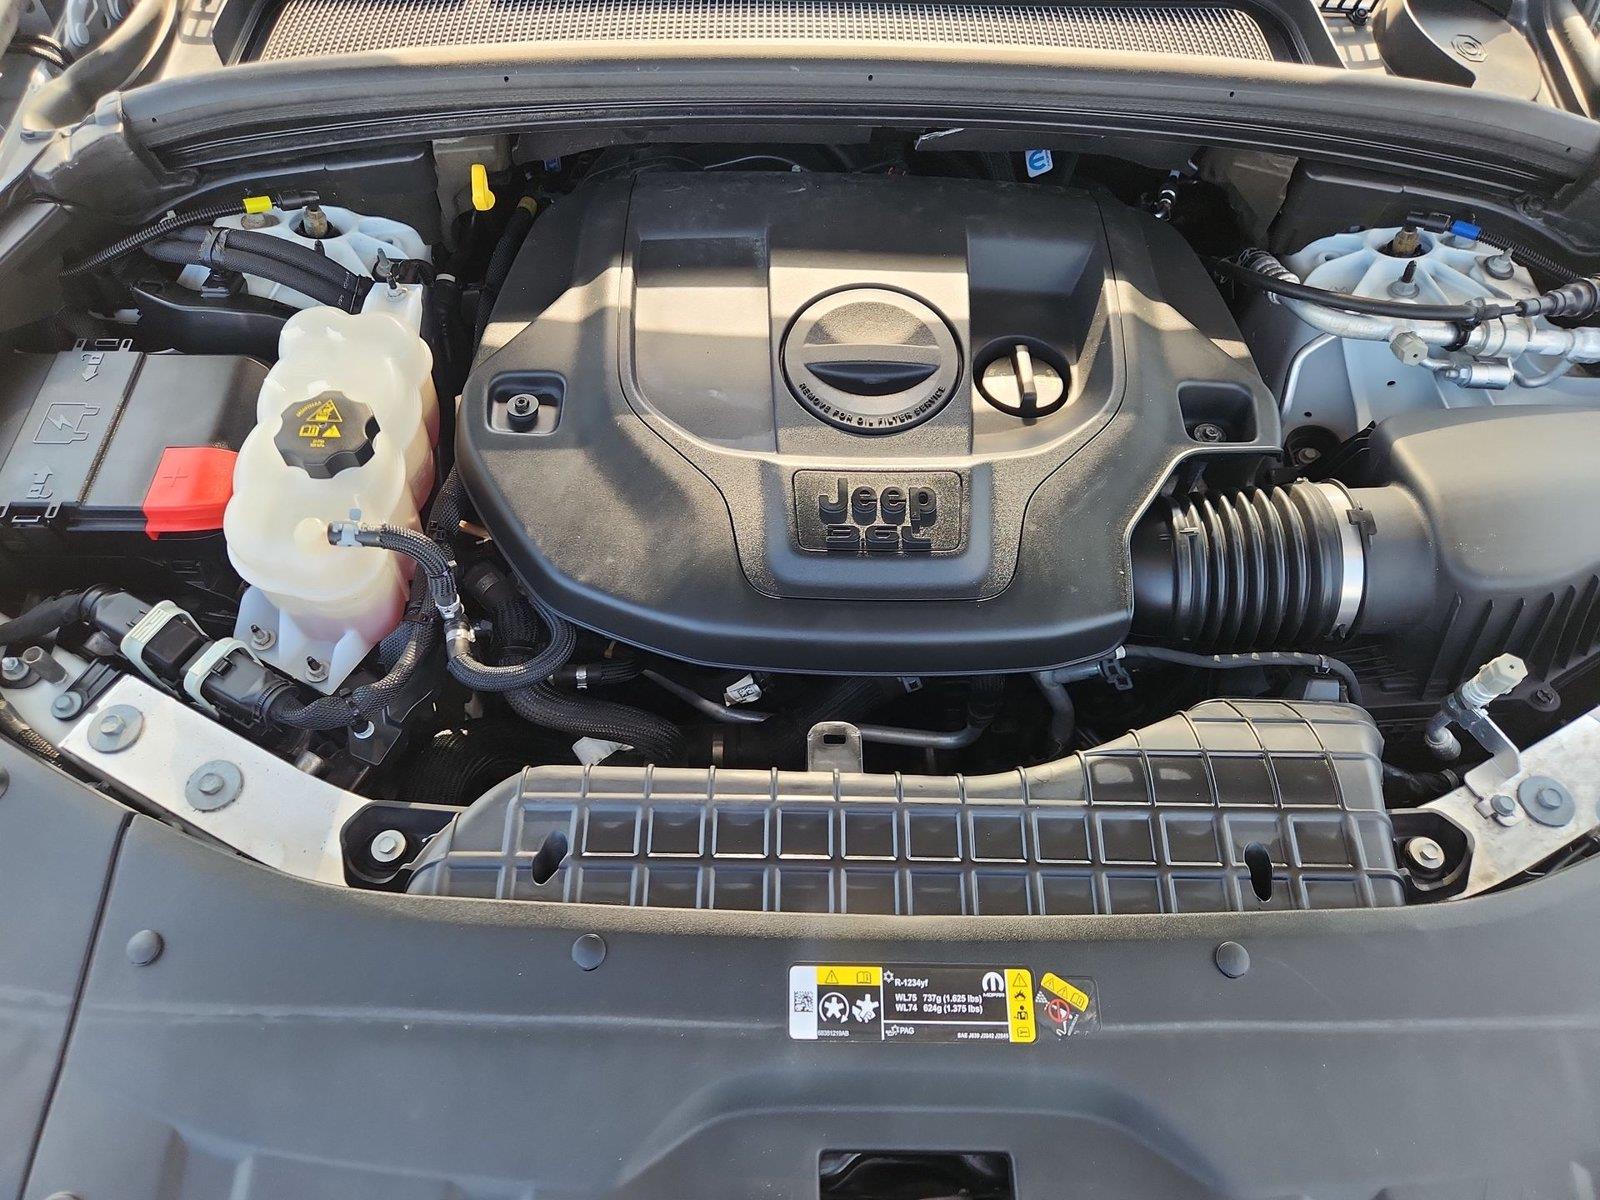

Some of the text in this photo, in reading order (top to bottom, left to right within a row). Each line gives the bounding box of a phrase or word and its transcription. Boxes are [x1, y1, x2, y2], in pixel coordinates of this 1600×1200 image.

[798, 382, 946, 427] REMOVE FOR OIL FILTER SERVICE
[818, 477, 938, 528] Jeep
[894, 978, 929, 989] R-1234yf
[895, 993, 983, 1004] WL75 737g (1.625 lbs)
[895, 1003, 984, 1014] WL74 624g (1.375 lbs)
[900, 1026, 914, 1035] PAG
